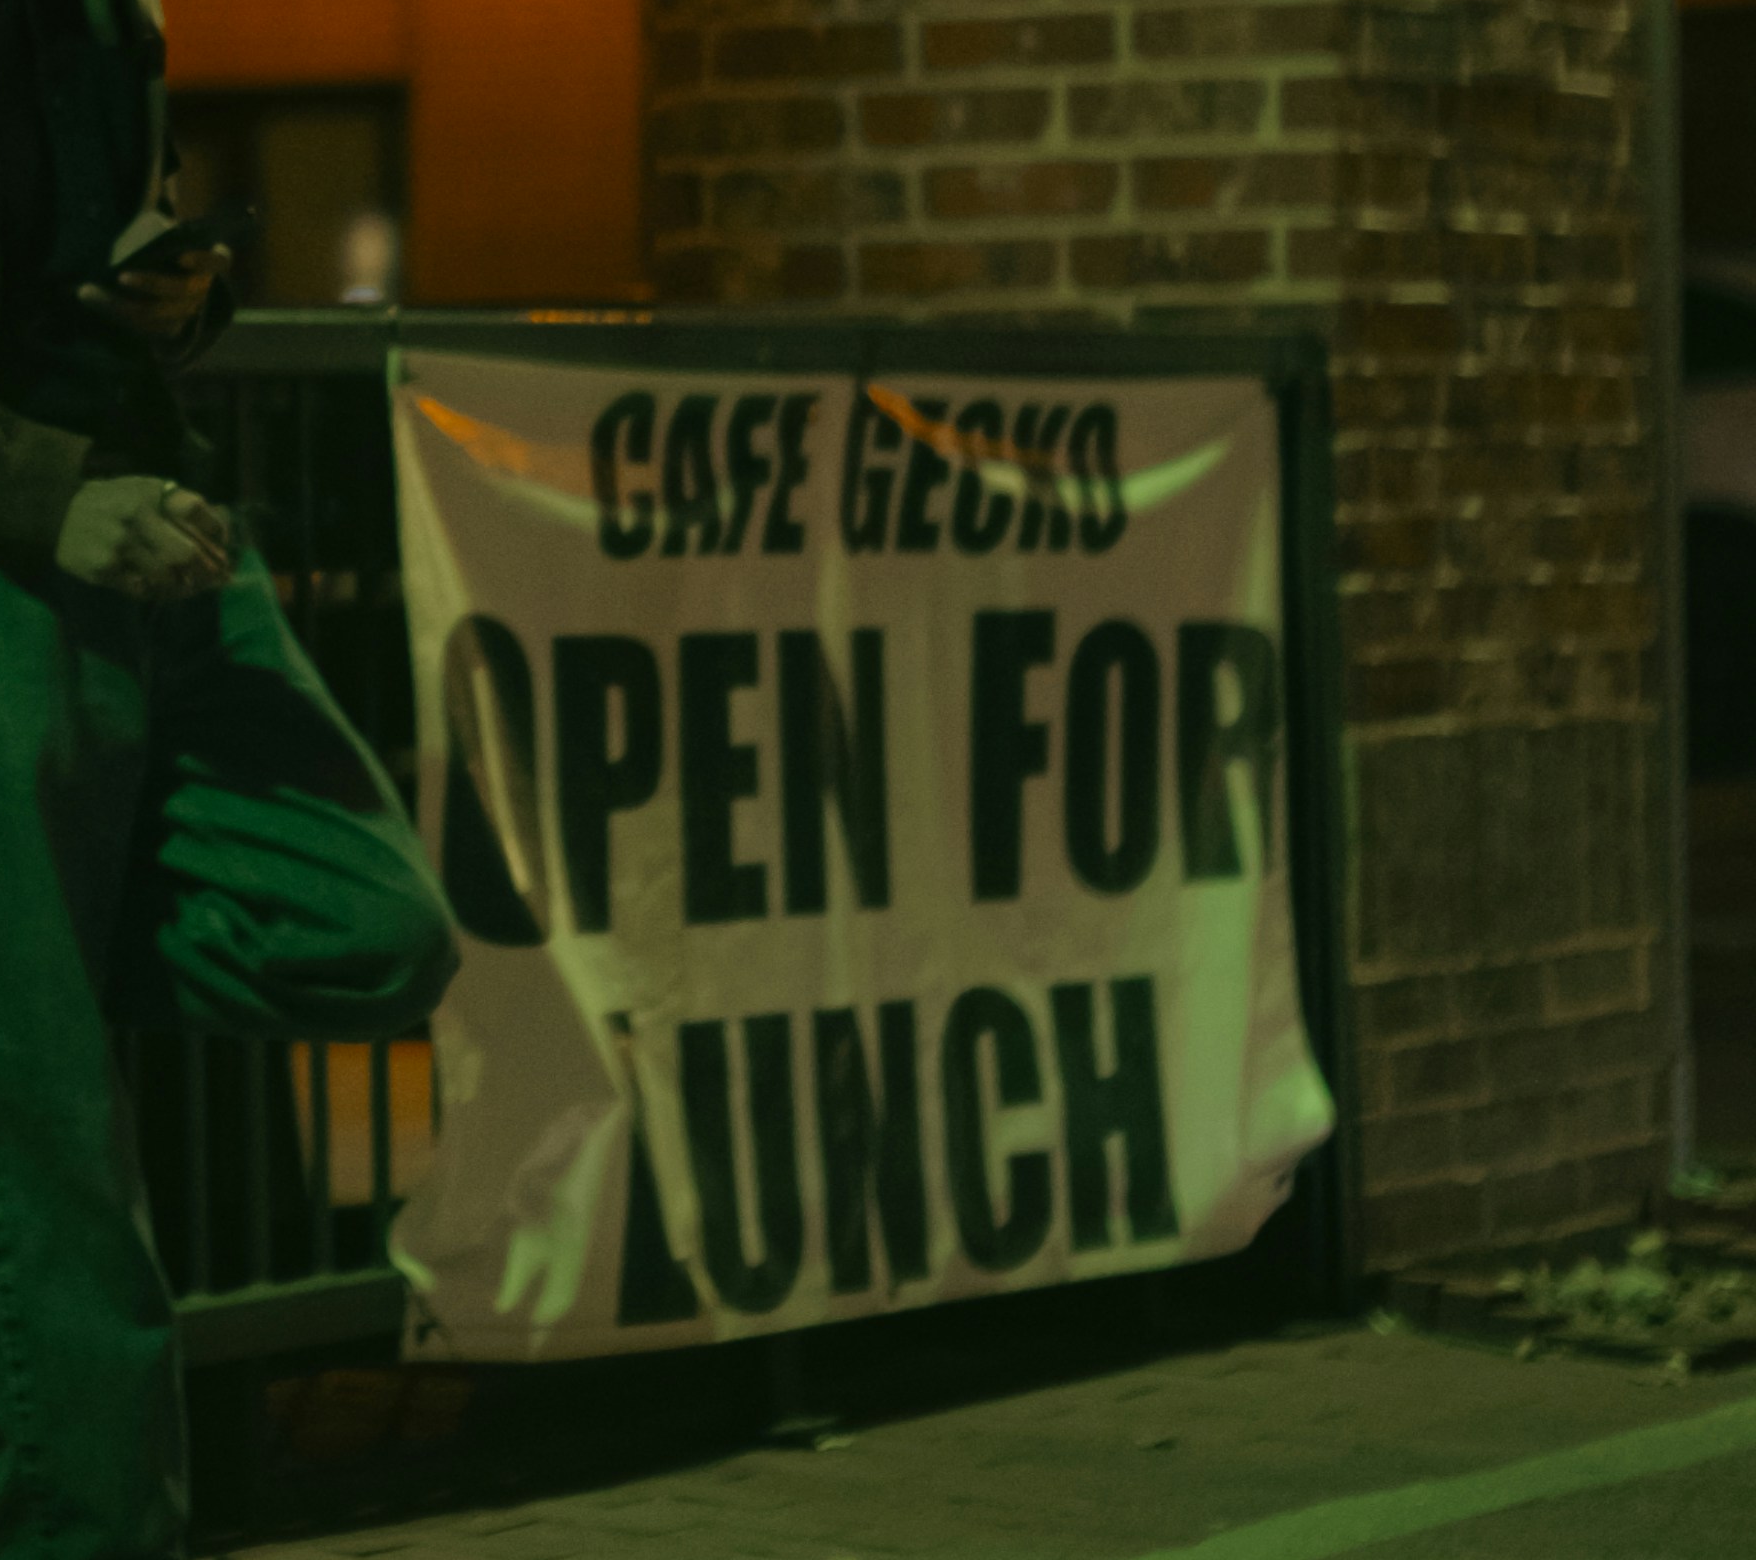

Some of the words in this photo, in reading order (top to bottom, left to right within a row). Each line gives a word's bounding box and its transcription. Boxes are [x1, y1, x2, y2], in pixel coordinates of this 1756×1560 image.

[589, 389, 820, 559] CAFE
[844, 398, 1128, 554] GECKO
[444, 613, 891, 948] OPEN
[970, 609, 1281, 904] FOR
